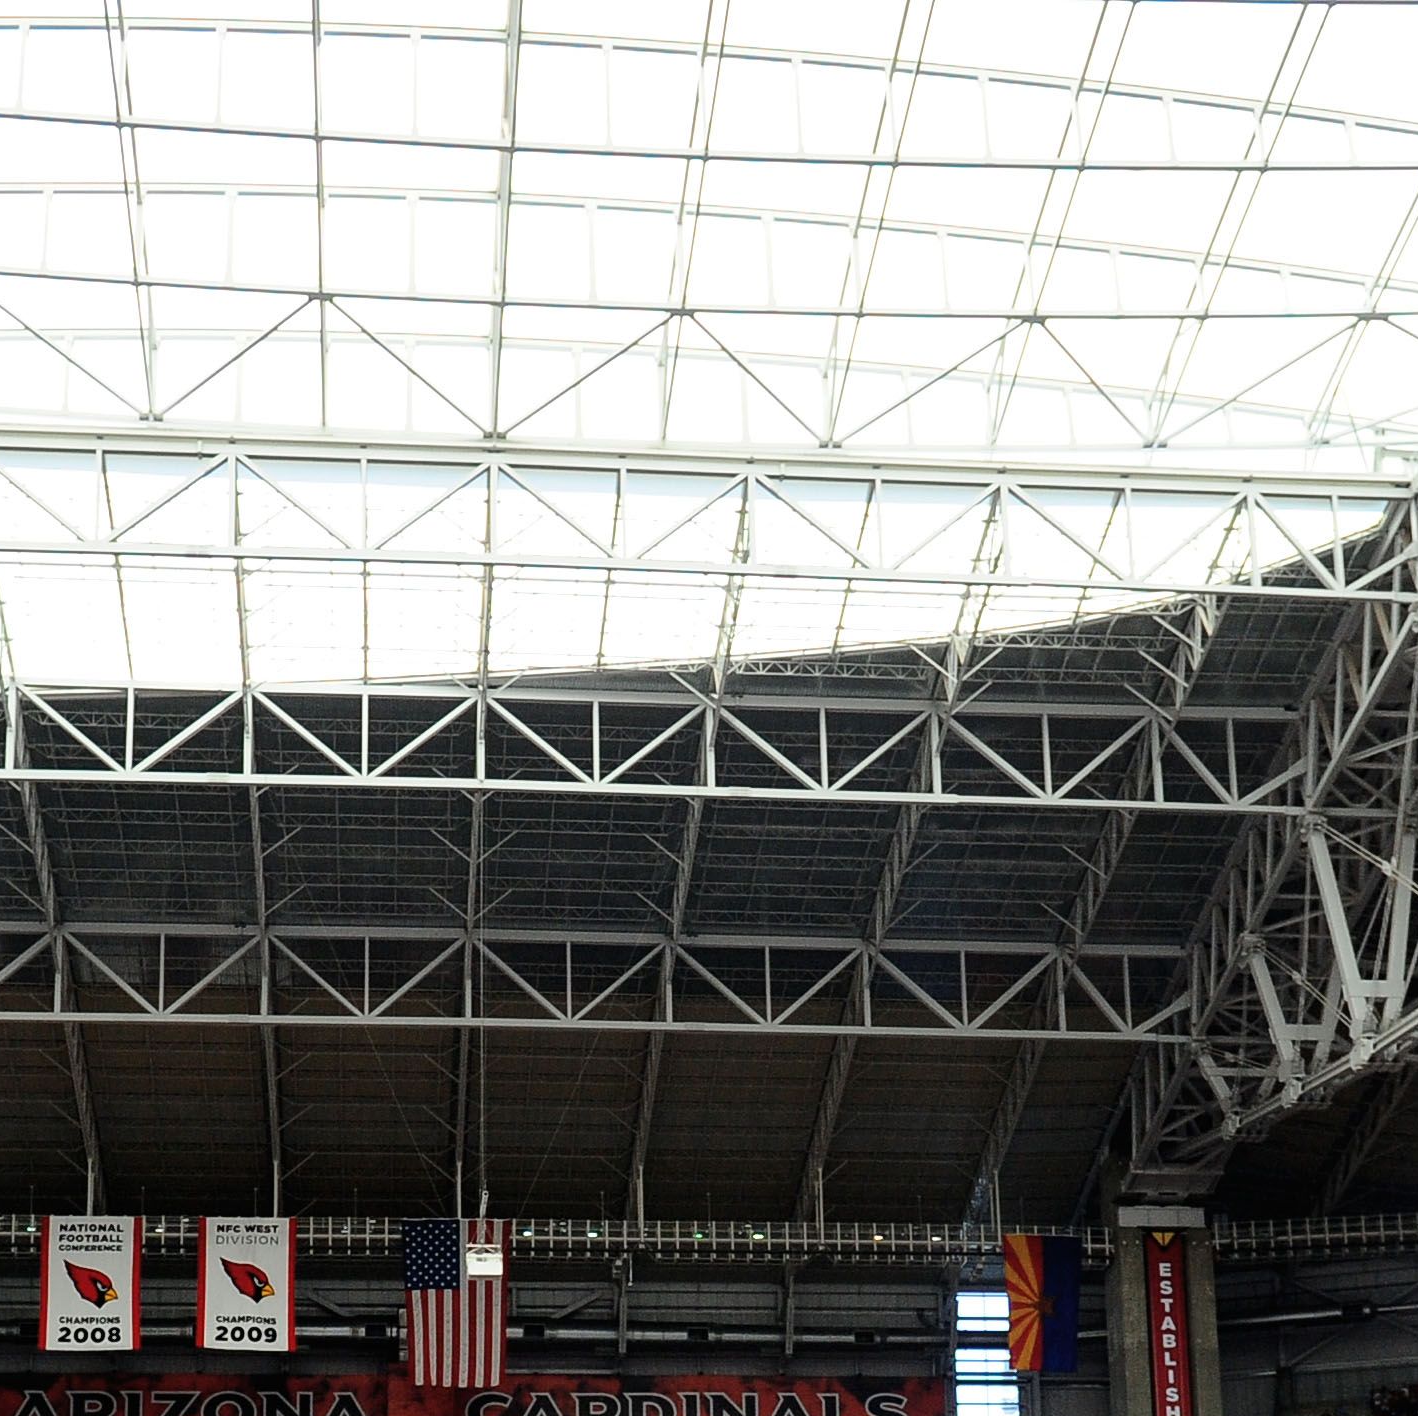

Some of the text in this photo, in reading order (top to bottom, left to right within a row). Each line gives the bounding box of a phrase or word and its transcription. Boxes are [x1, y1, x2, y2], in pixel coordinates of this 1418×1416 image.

[59, 1223, 124, 1233] NATIONAL
[216, 1224, 279, 1234] NFC WEST
[59, 1234, 123, 1243] FOOTBALL
[216, 1235, 279, 1245] DIVISION
[59, 1316, 120, 1324] CHAMPIONS
[216, 1316, 276, 1325] CHAMPIONS
[57, 1327, 121, 1343] 2008
[215, 1326, 277, 1343] 2009
